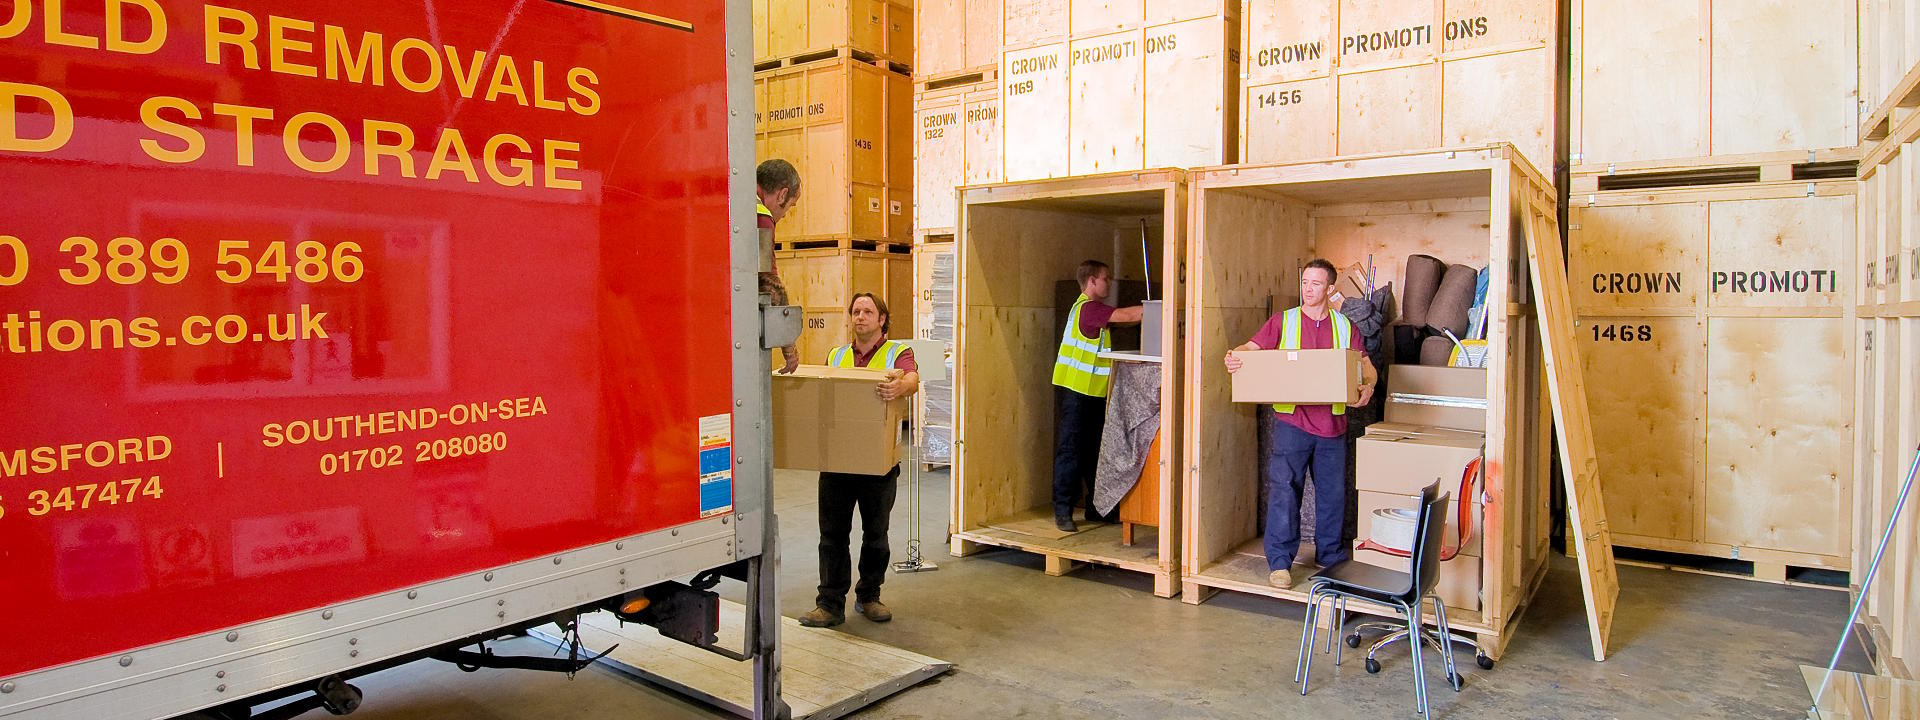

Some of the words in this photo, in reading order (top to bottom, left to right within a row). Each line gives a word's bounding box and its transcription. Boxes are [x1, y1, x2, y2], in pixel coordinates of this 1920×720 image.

[204, 3, 601, 116] REMOVALS
[1011, 54, 1058, 75] CROWN
[1258, 41, 1321, 67] CROWN
[1009, 80, 1034, 96] 1169
[1258, 89, 1302, 108] 1456
[923, 112, 957, 128] CROWN
[967, 106, 998, 123] PROM
[139, 96, 584, 192] STORAGE
[854, 138, 872, 150] 1436
[924, 128, 944, 140] 1322
[59, 236, 190, 285] 389
[215, 239, 364, 284] 5486
[1592, 272, 1682, 294] CROWN
[1712, 270, 1836, 293] PROMOTI
[0, 303, 329, 354] tions.co.uk
[808, 318, 825, 329] ONS
[1592, 324, 1652, 342] 1468
[262, 396, 548, 448] SOUTHEND-ON-SEA
[319, 444, 403, 476] 01702
[415, 431, 507, 463] 208080
[27, 475, 164, 517] 347474
